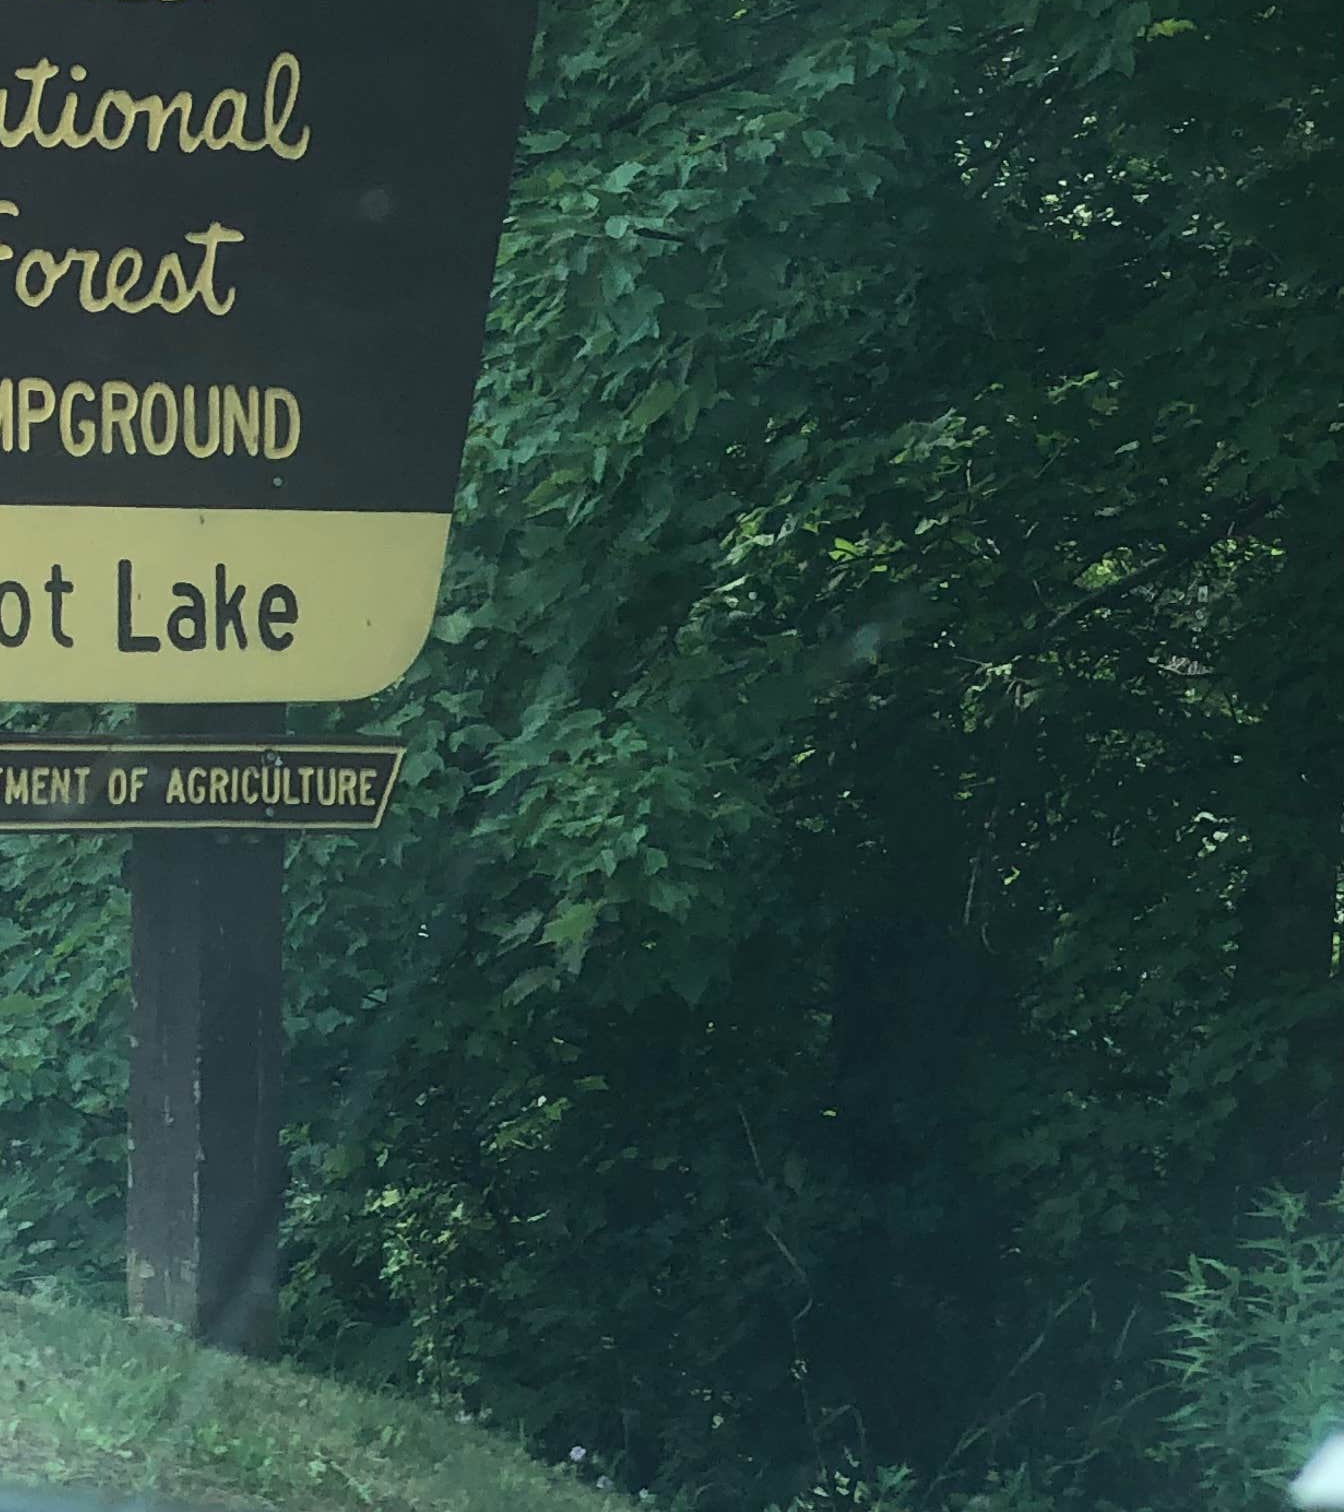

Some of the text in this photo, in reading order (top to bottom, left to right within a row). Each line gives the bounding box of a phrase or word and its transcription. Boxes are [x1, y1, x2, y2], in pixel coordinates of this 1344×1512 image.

[116, 557, 300, 654] Lake
[107, 767, 150, 806] OF
[165, 766, 378, 807] AGRICULTURE
